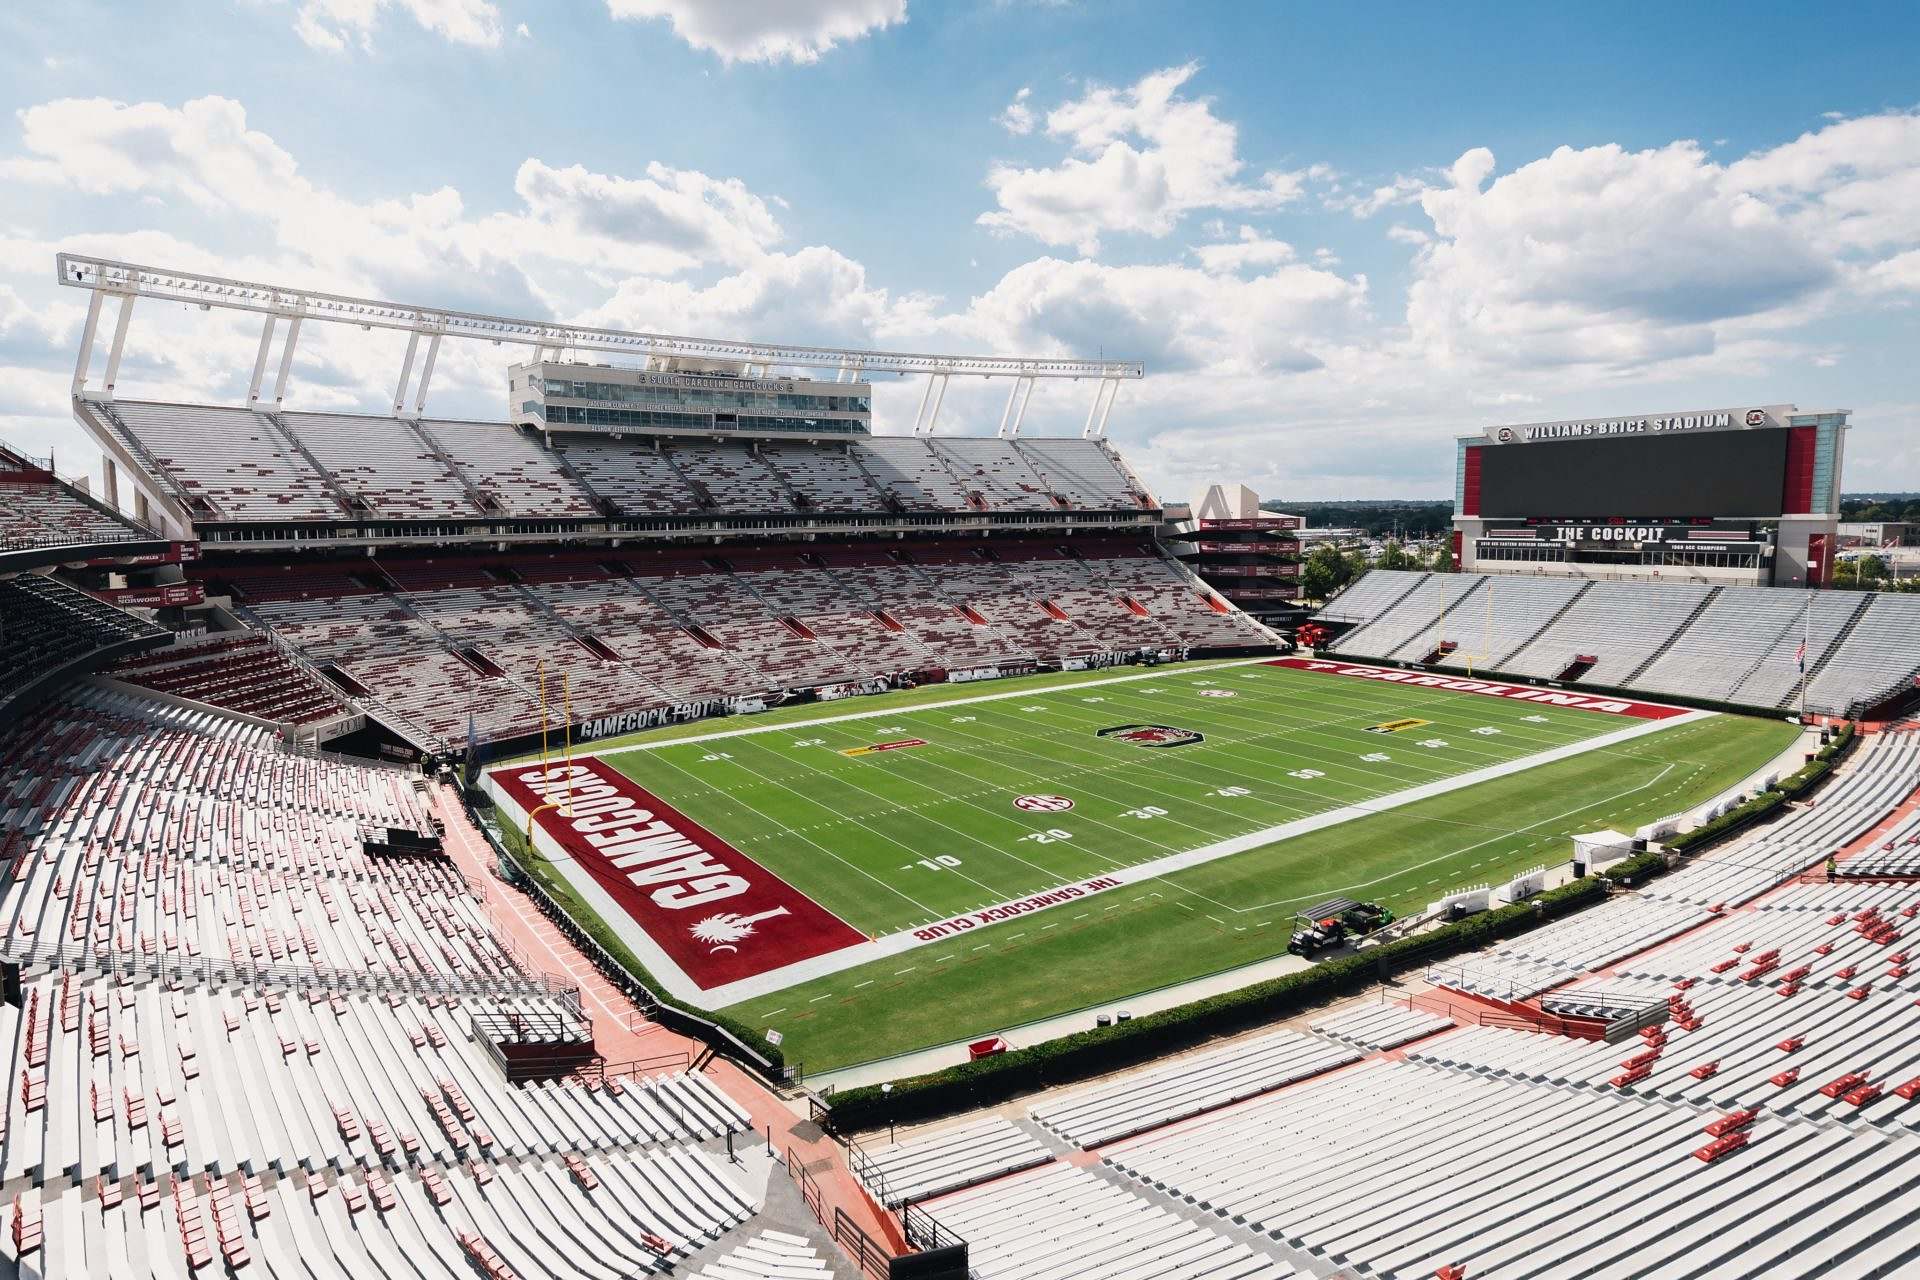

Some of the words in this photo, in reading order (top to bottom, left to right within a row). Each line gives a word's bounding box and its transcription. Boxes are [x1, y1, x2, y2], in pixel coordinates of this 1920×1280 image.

[651, 375, 680, 385] SOUTH
[685, 378, 728, 388] CAROLINA
[733, 382, 785, 391] GAMECOCKS
[1524, 419, 1646, 439] WILLIAMS-BRICE
[1653, 413, 1730, 431] STADIUM
[1556, 527, 1584, 541] THE
[1591, 527, 1664, 541] COCKPIT
[1336, 668, 1633, 713] CAROLINA
[581, 709, 669, 738] GAMECOCK
[1217, 786, 1251, 797] 40
[1126, 806, 1169, 819] 30
[518, 765, 751, 910] GAMECOCKS
[1027, 829, 1073, 844] 20
[916, 855, 962, 871] 10
[1083, 877, 1123, 892] THE
[972, 888, 1086, 924] GAMECOCK
[913, 920, 976, 941] CLUB
